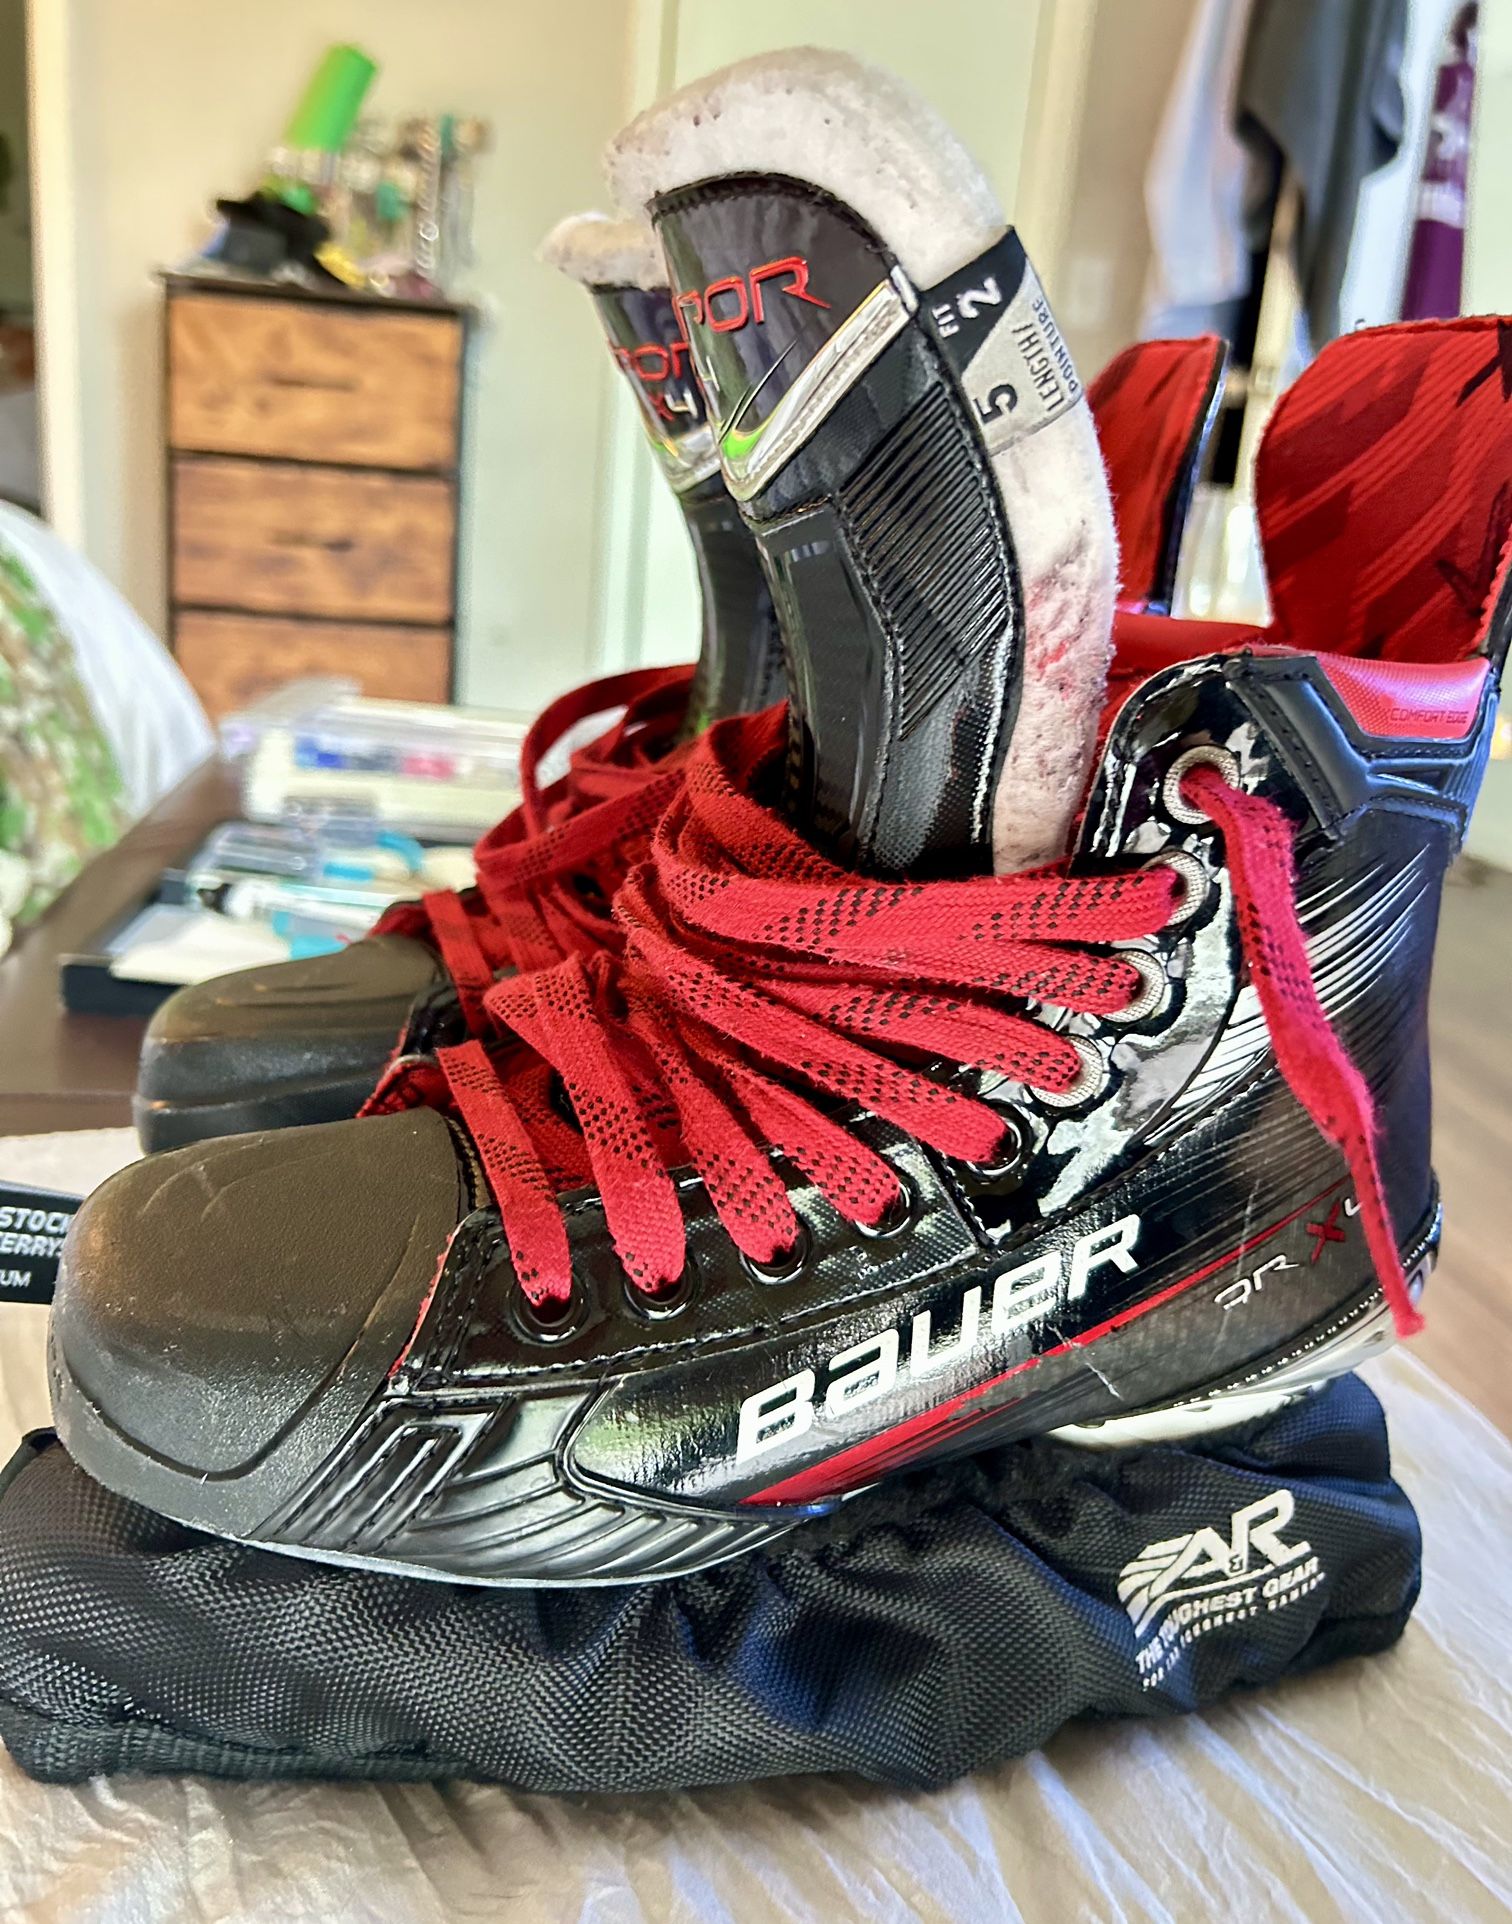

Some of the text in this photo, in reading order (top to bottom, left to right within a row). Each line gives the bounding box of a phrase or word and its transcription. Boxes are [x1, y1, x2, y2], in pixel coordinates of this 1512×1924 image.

[956, 276, 1003, 319] 2
[932, 304, 960, 339] FIT
[973, 383, 1018, 424] 5
[1262, 1556, 1319, 1598] GEAR
